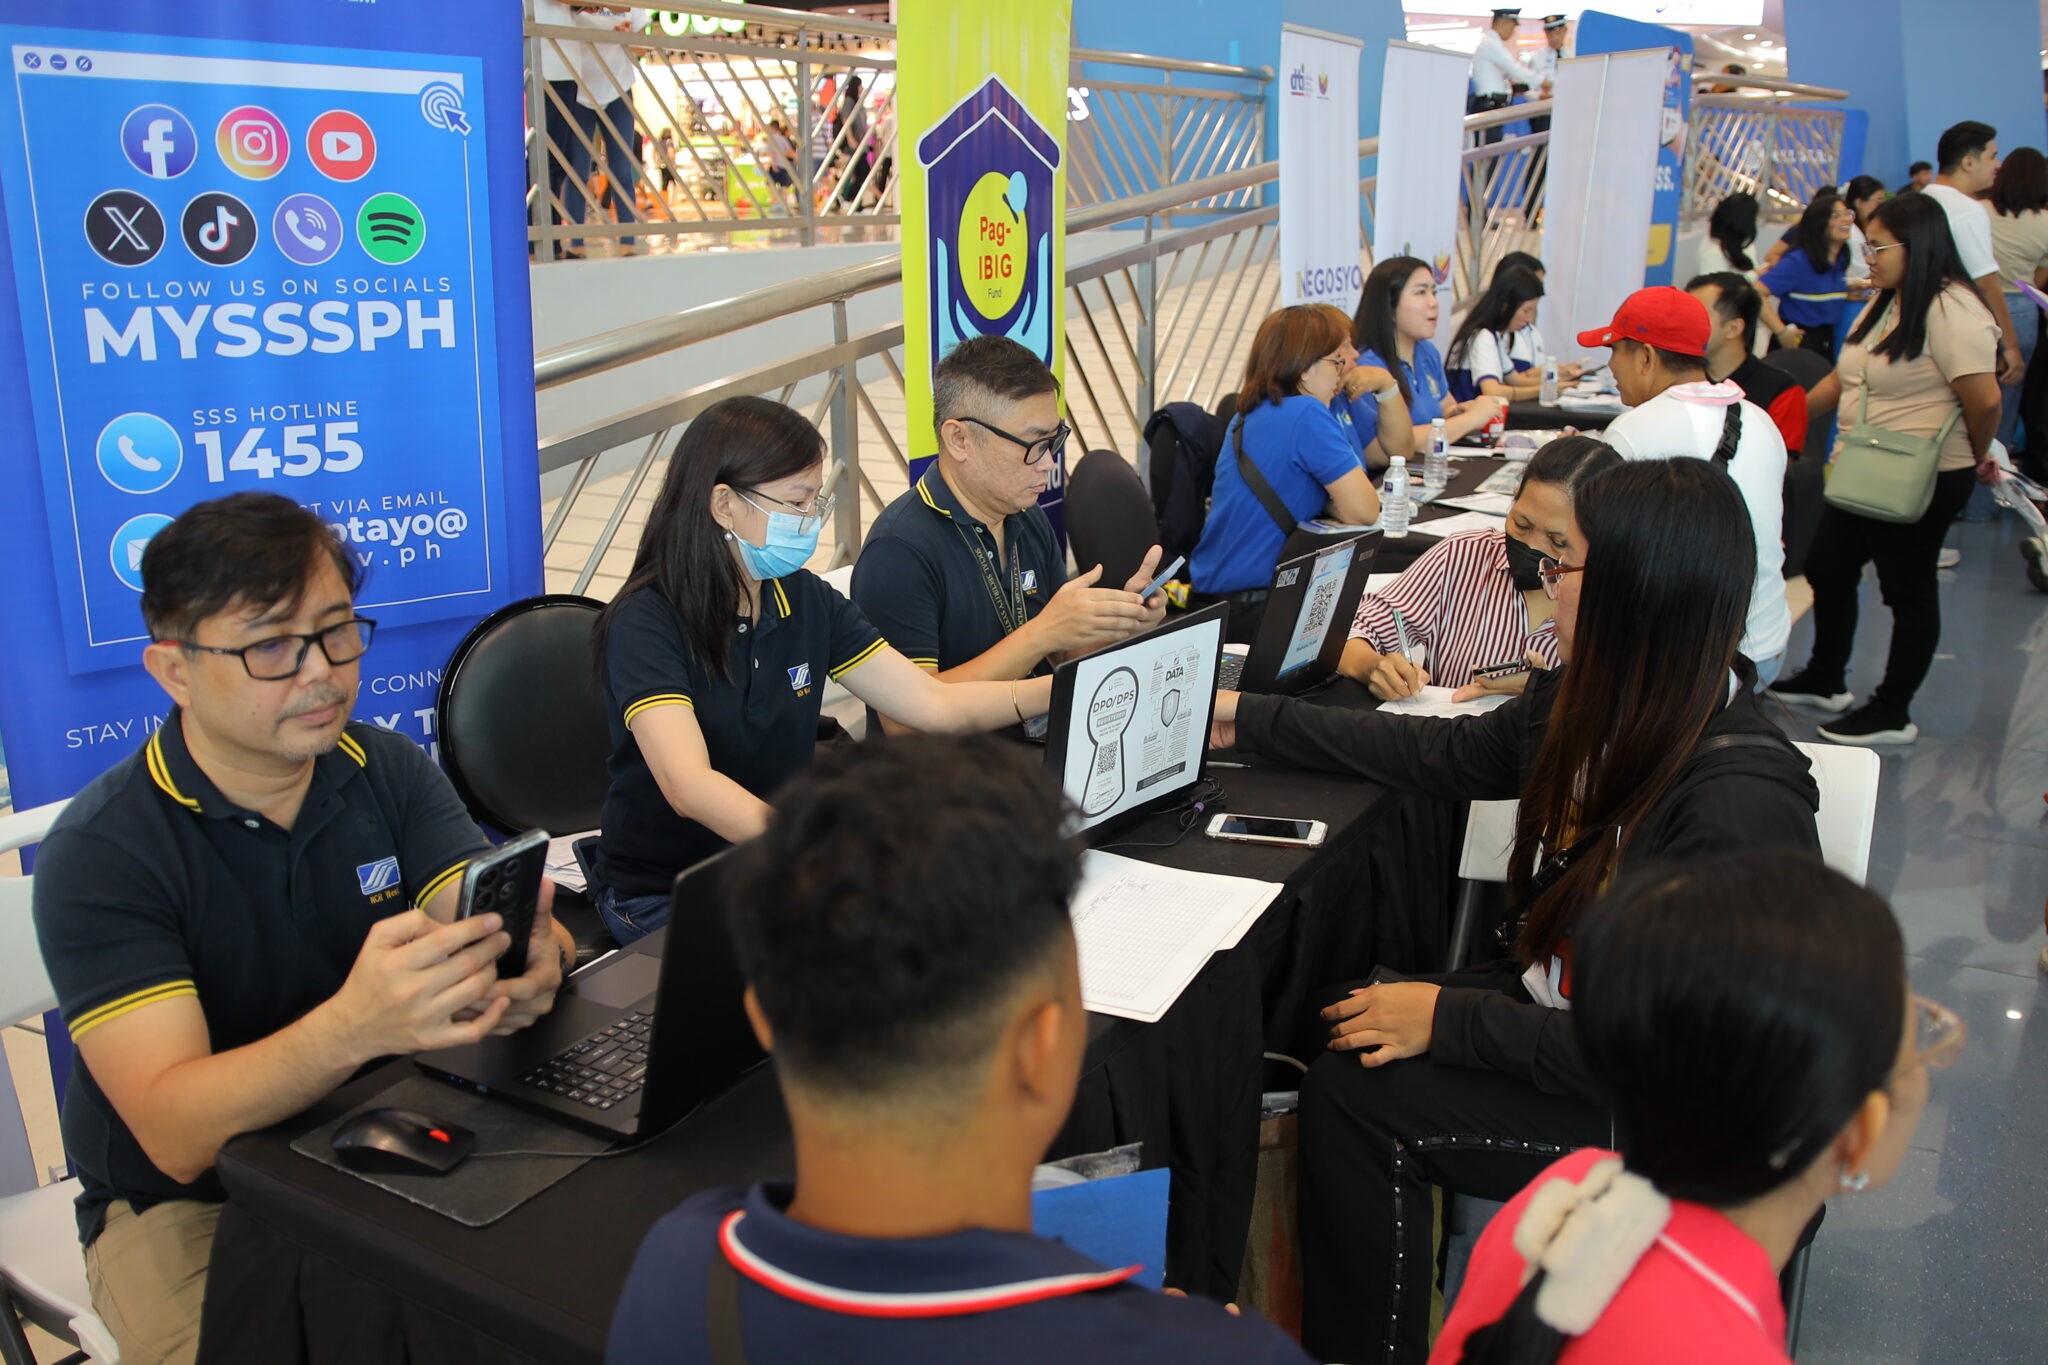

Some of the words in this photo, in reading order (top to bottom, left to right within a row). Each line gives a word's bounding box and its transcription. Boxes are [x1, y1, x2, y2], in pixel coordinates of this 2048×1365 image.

[980, 216, 1011, 247] Pag-
[979, 253, 1012, 280] IBIG
[1296, 262, 1361, 298] NEGOSYO
[82, 280, 212, 300] FOLLOW
[230, 279, 266, 296] US
[282, 278, 319, 295] ON
[335, 277, 451, 294] SOCIALS
[988, 288, 1002, 298] Fund
[84, 299, 456, 364] MYSSSPH
[193, 407, 237, 426] SSS
[250, 401, 359, 422] HOTLINE
[195, 421, 364, 483] 1455
[331, 498, 371, 515] VIA
[382, 490, 449, 511] EMAIL
[975, 547, 989, 574] SOCIAL
[986, 573, 1005, 609] SECURITY
[1001, 610, 1014, 634] SYSTE
[371, 668, 445, 695] CONN
[1165, 666, 1184, 681] DATA
[1093, 689, 1135, 714] DPO/DPS
[66, 718, 134, 749] STAY
